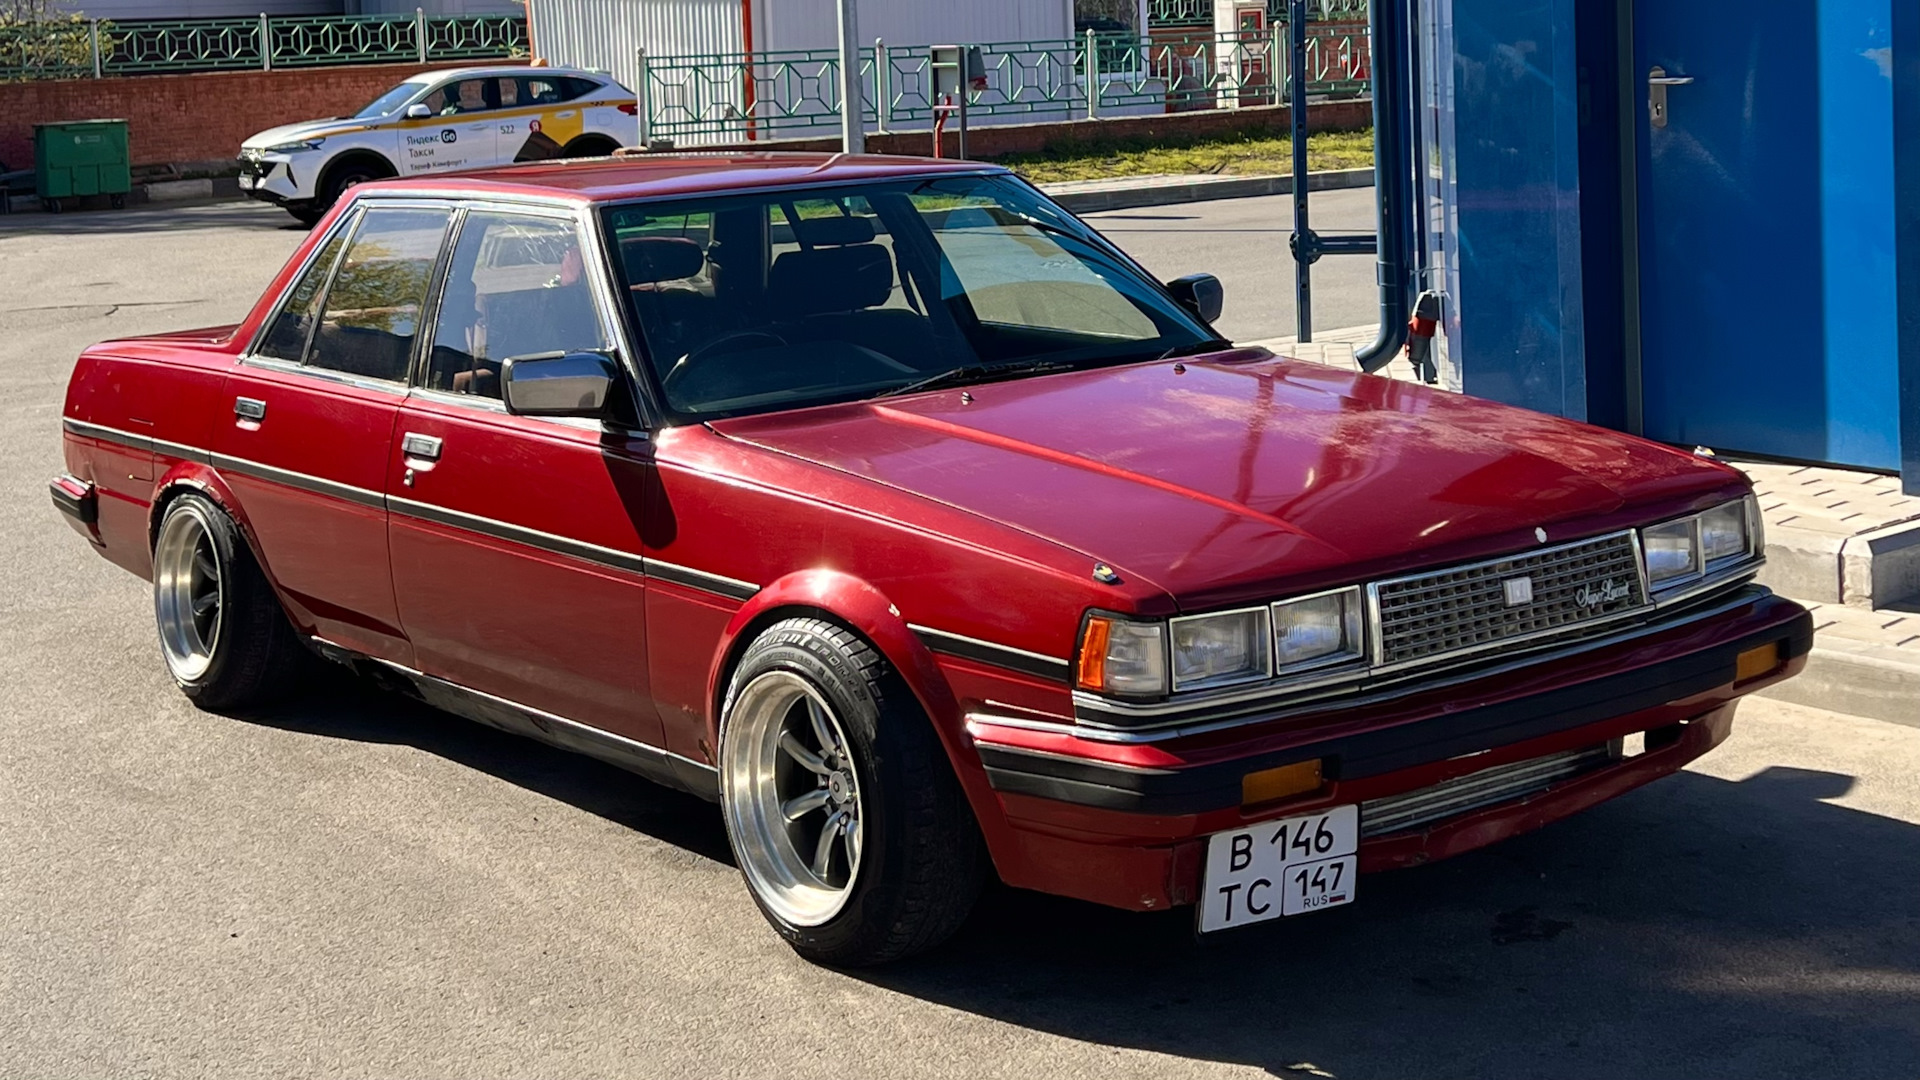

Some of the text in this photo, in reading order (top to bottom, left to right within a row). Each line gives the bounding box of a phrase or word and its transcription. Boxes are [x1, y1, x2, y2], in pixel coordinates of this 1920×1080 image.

[500, 124, 515, 134] 522
[407, 130, 456, 145] Яндекс Go
[408, 148, 434, 158] Такси
[1270, 816, 1334, 861] 146
[1295, 862, 1344, 897] 147
[1303, 895, 1328, 909] RUS
